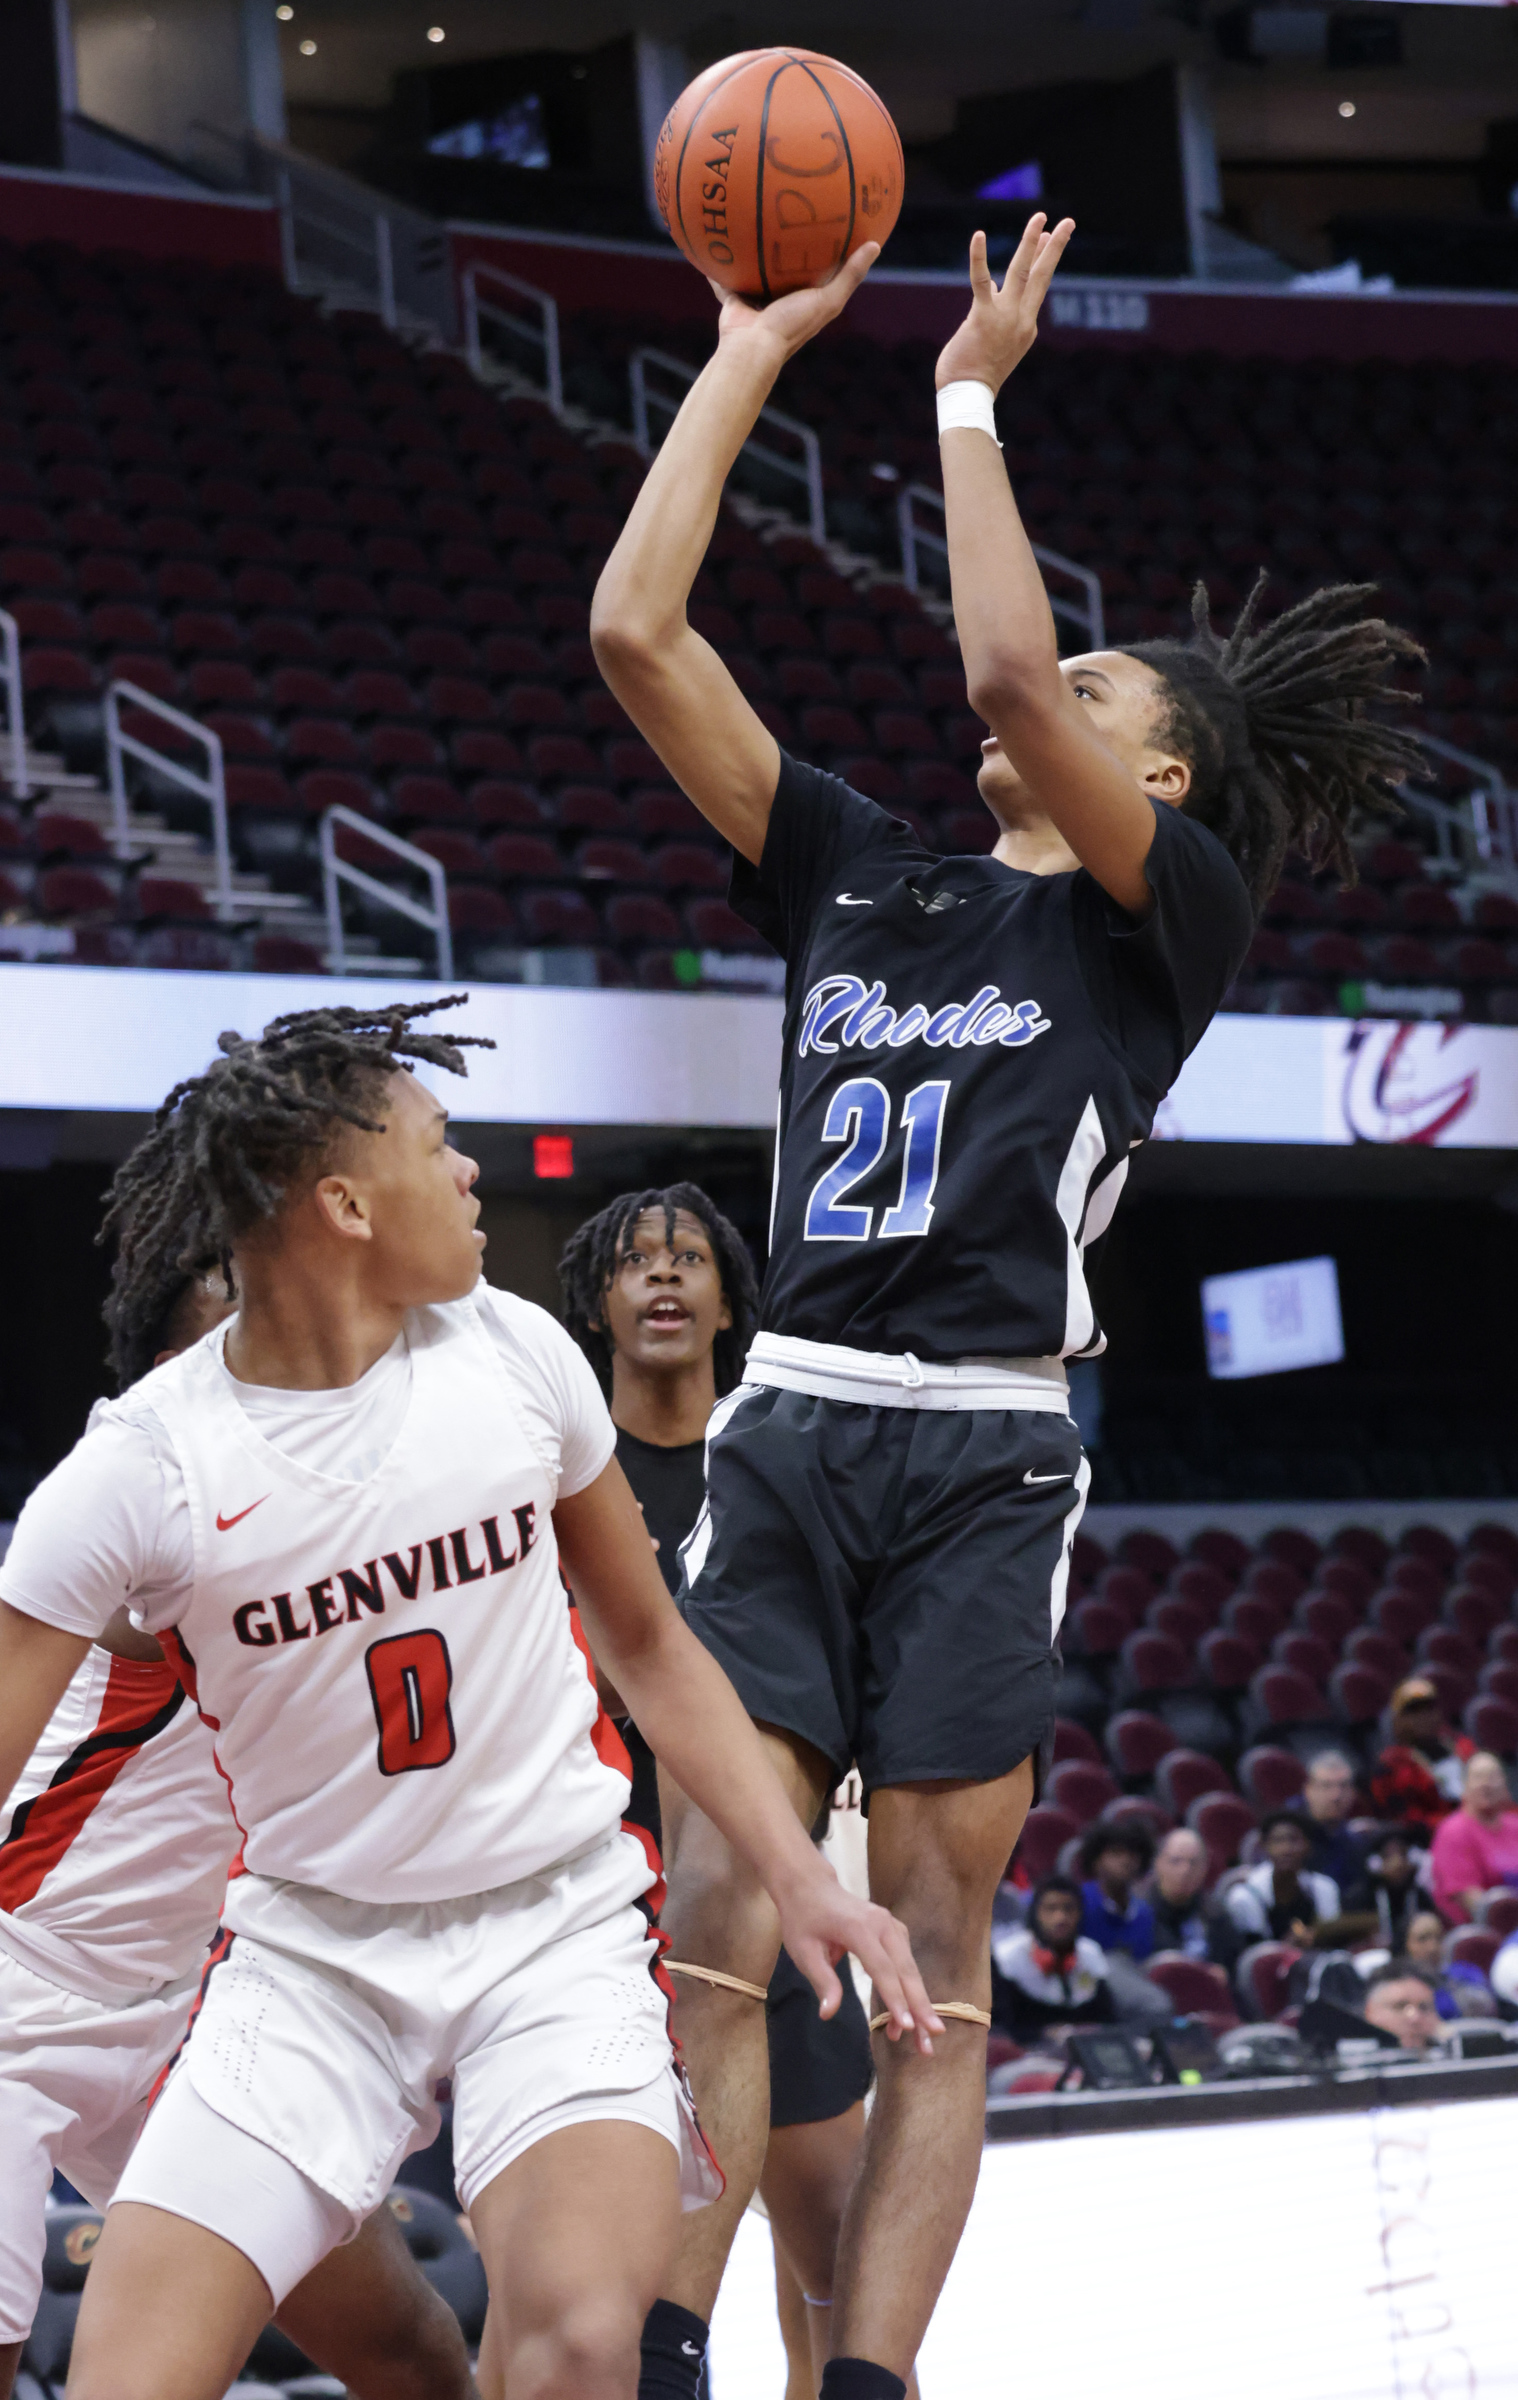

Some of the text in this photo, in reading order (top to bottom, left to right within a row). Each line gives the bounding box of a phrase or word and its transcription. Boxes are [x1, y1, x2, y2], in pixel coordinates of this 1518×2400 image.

[702, 125, 739, 266] OHSAA
[765, 131, 848, 276] EPC
[799, 974, 1051, 1058] Rhodes
[803, 1077, 951, 1241] 21
[233, 1501, 539, 1647] GLENVILLE
[365, 1628, 456, 1777] 0
